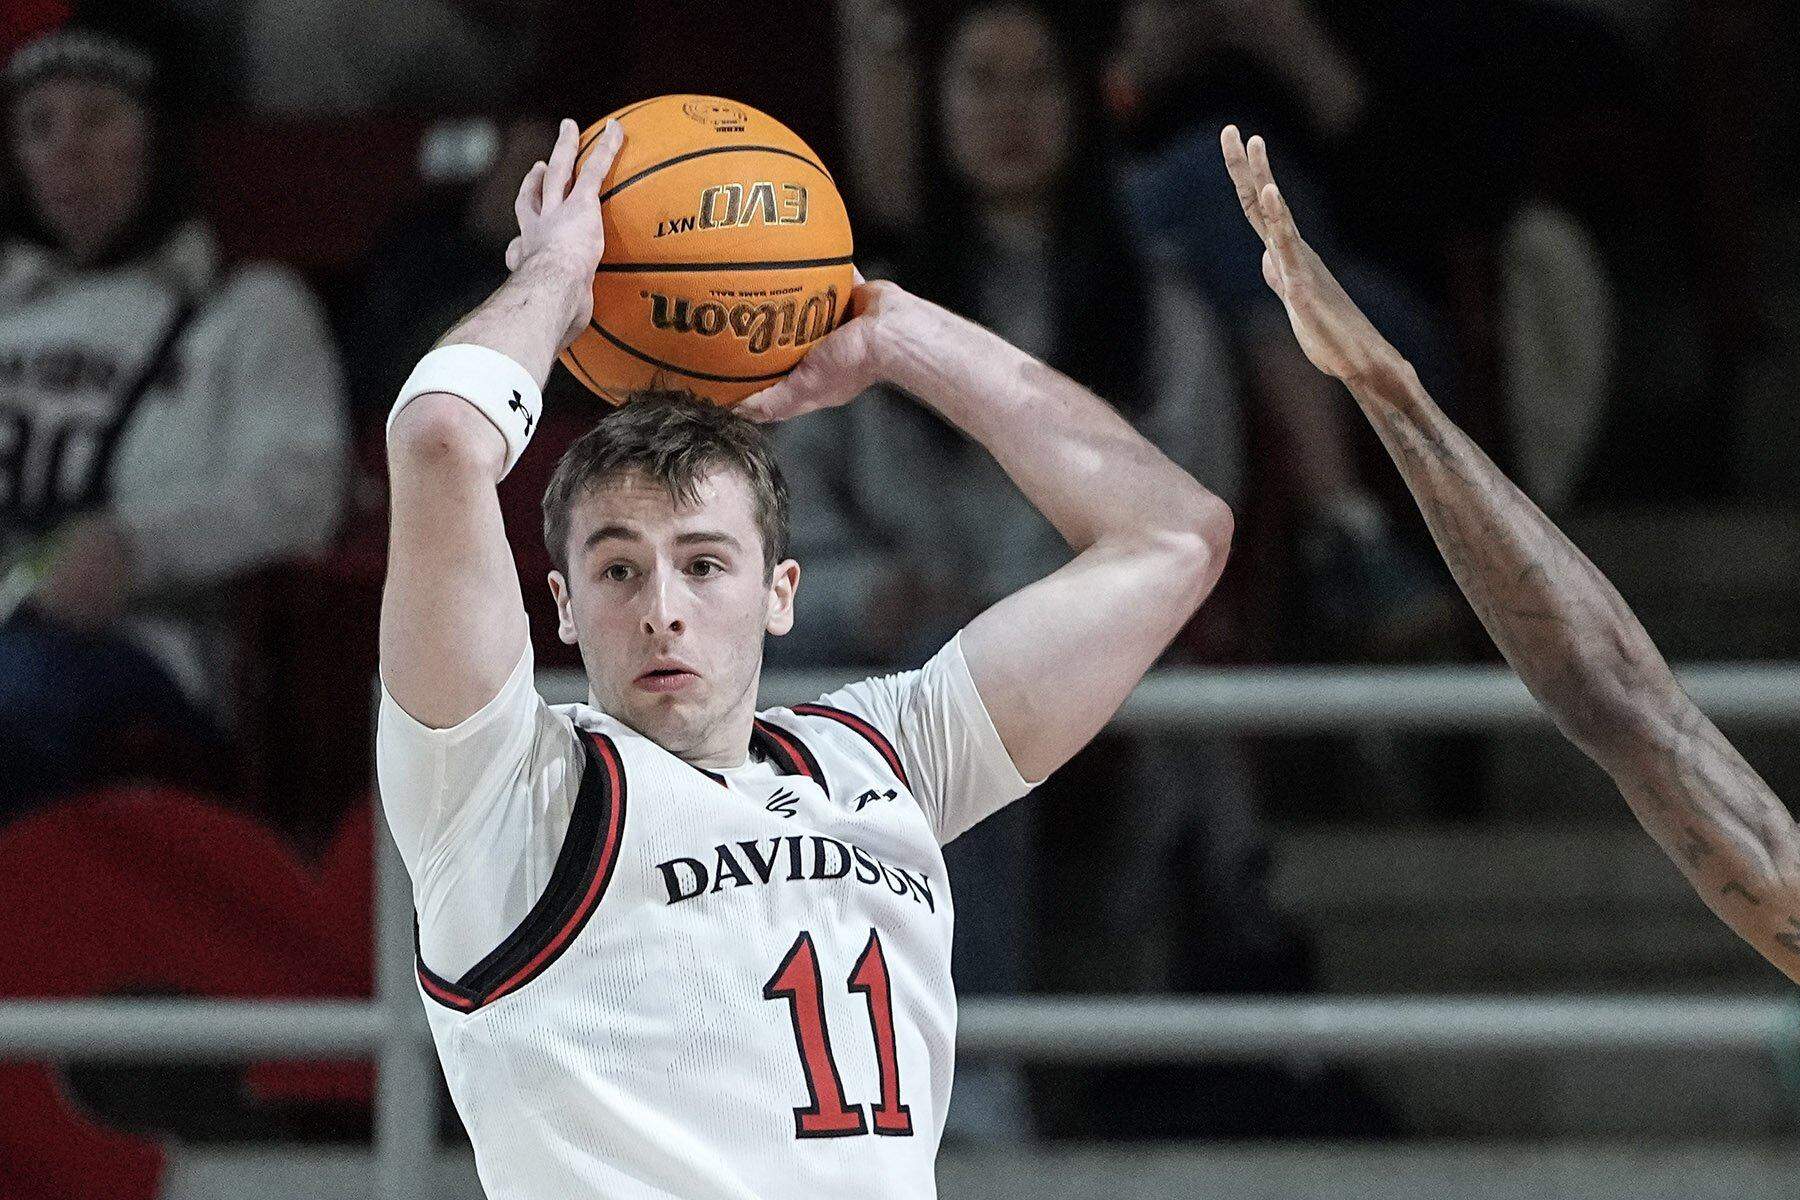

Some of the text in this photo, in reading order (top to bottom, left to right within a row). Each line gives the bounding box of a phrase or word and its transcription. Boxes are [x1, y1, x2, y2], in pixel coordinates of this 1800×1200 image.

[653, 181, 808, 238] EVO NXT
[651, 284, 837, 355] Wilson
[655, 835, 935, 914] DAVIDSON
[763, 927, 914, 1140] 11
